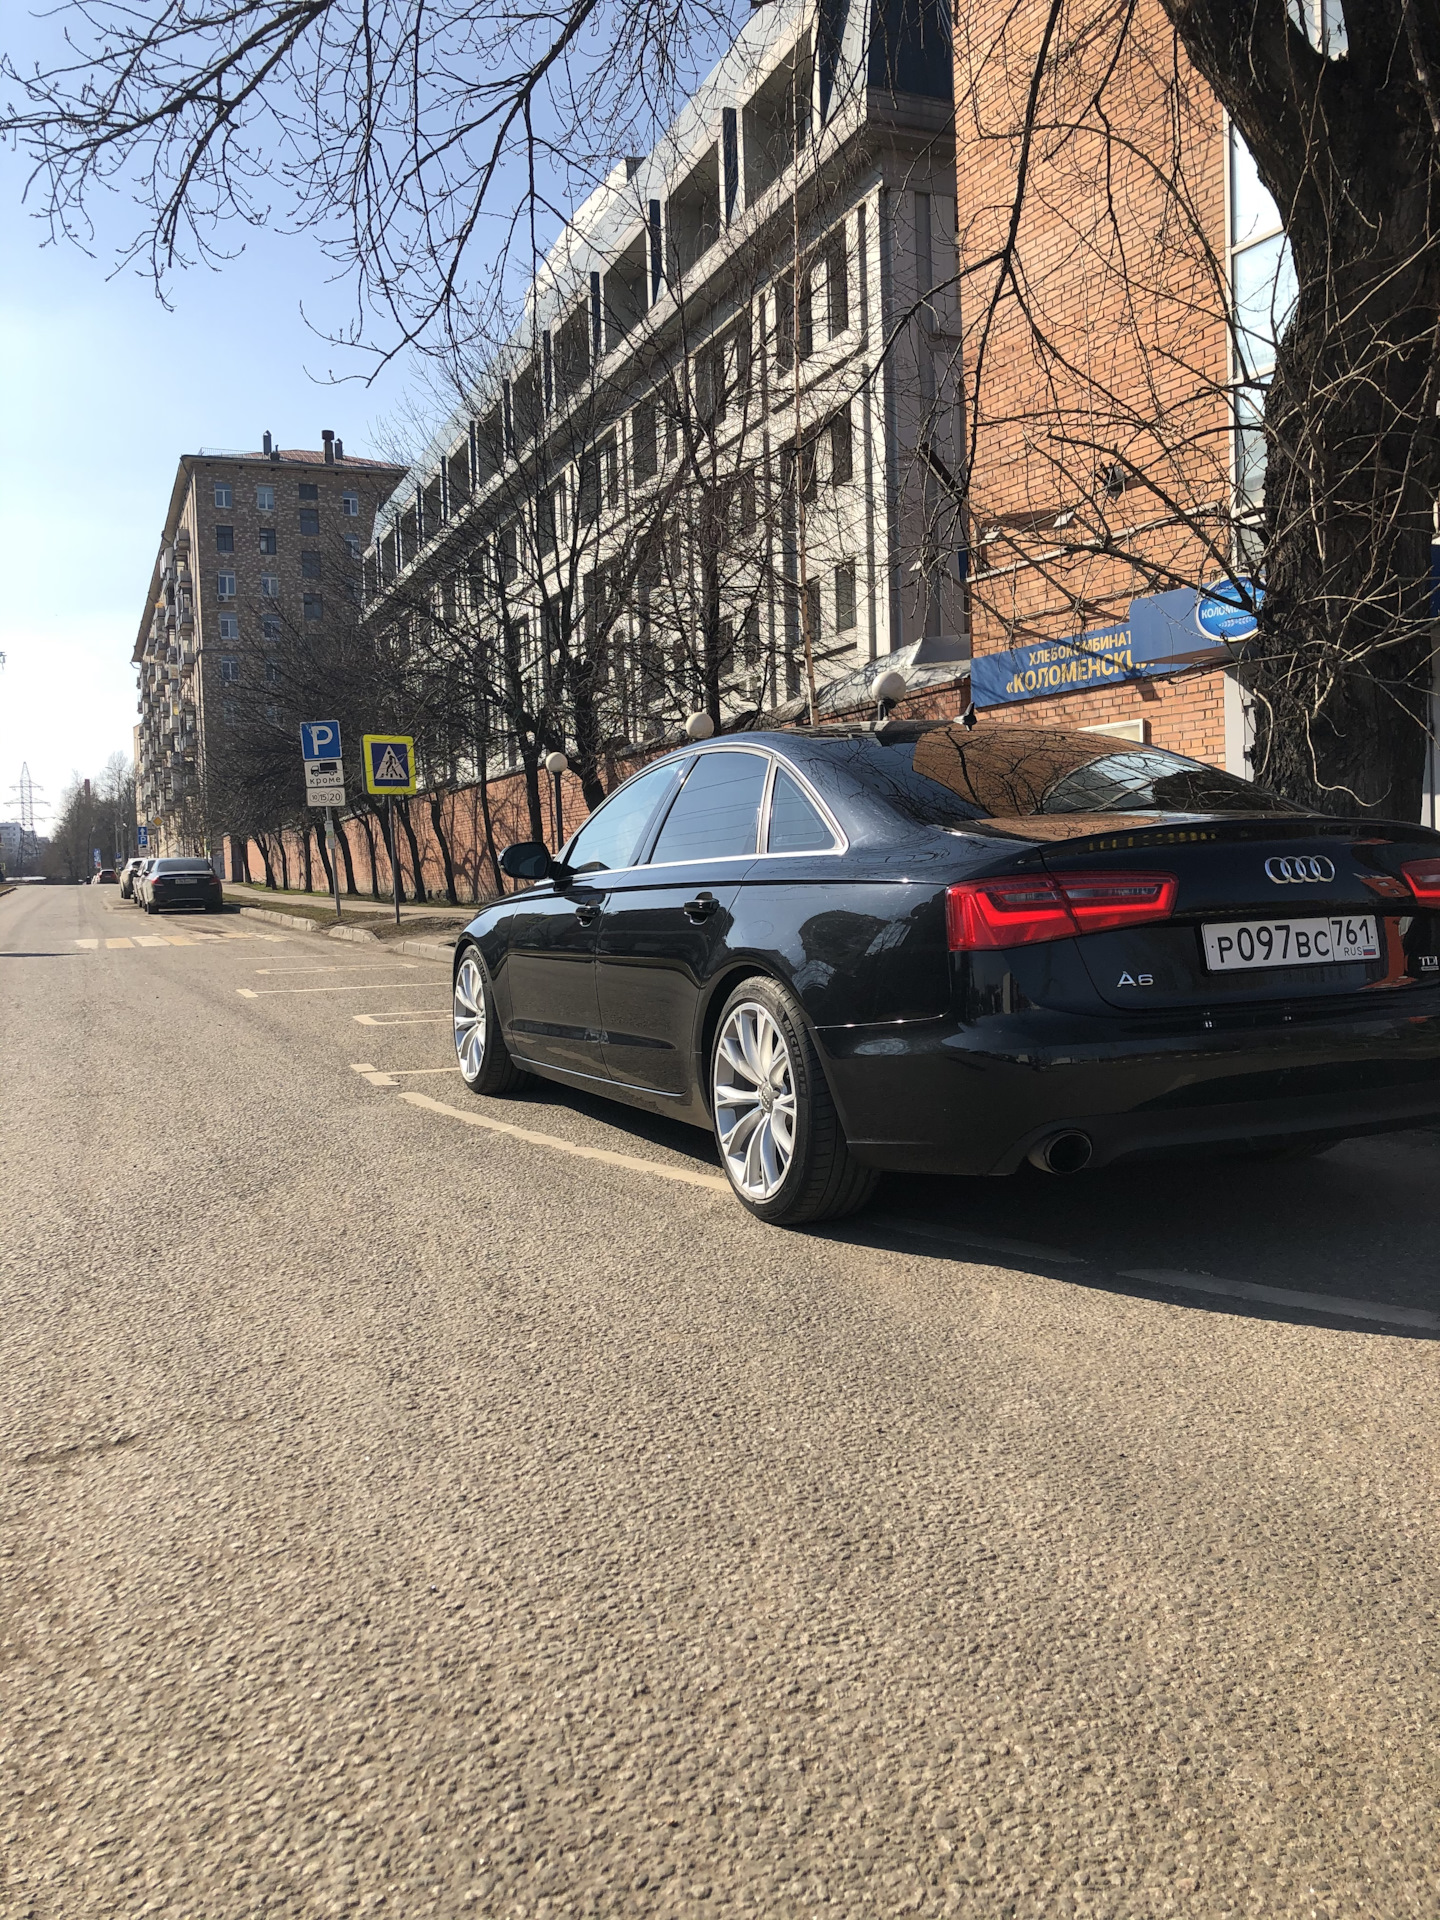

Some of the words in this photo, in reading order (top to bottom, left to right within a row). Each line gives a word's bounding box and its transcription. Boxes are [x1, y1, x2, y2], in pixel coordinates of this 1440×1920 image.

[310, 725, 333, 756] P
[309, 776, 341, 786] кроме
[320, 793, 327, 801] 15
[329, 793, 341, 801] 20
[140, 836, 147, 844] P
[1331, 919, 1371, 946] 761
[1344, 947, 1363, 956] RUS
[1418, 955, 1438, 966] TDI
[1116, 970, 1154, 988] A6
